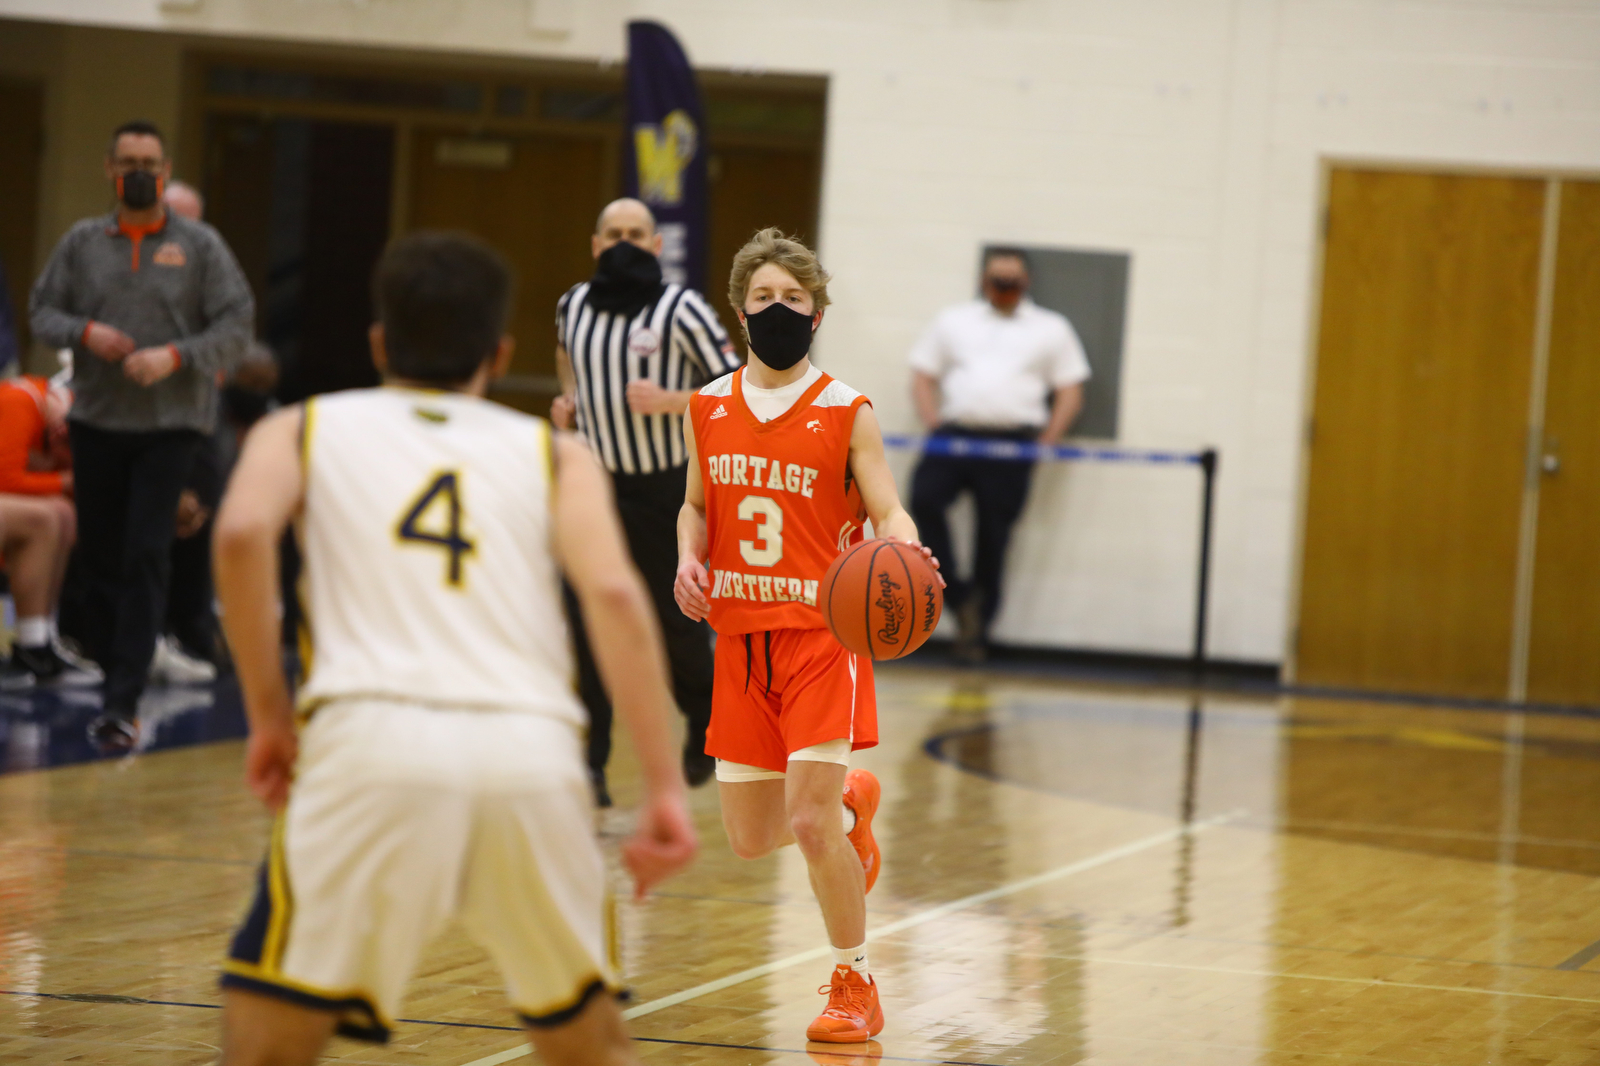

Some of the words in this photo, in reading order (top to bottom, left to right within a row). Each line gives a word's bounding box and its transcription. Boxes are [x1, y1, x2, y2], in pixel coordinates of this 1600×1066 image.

[708, 454, 819, 499] PORTAGE
[394, 467, 478, 590] 4
[737, 495, 784, 568] 3
[710, 569, 819, 607] NORTHERN
[875, 570, 901, 645] Rawlings
